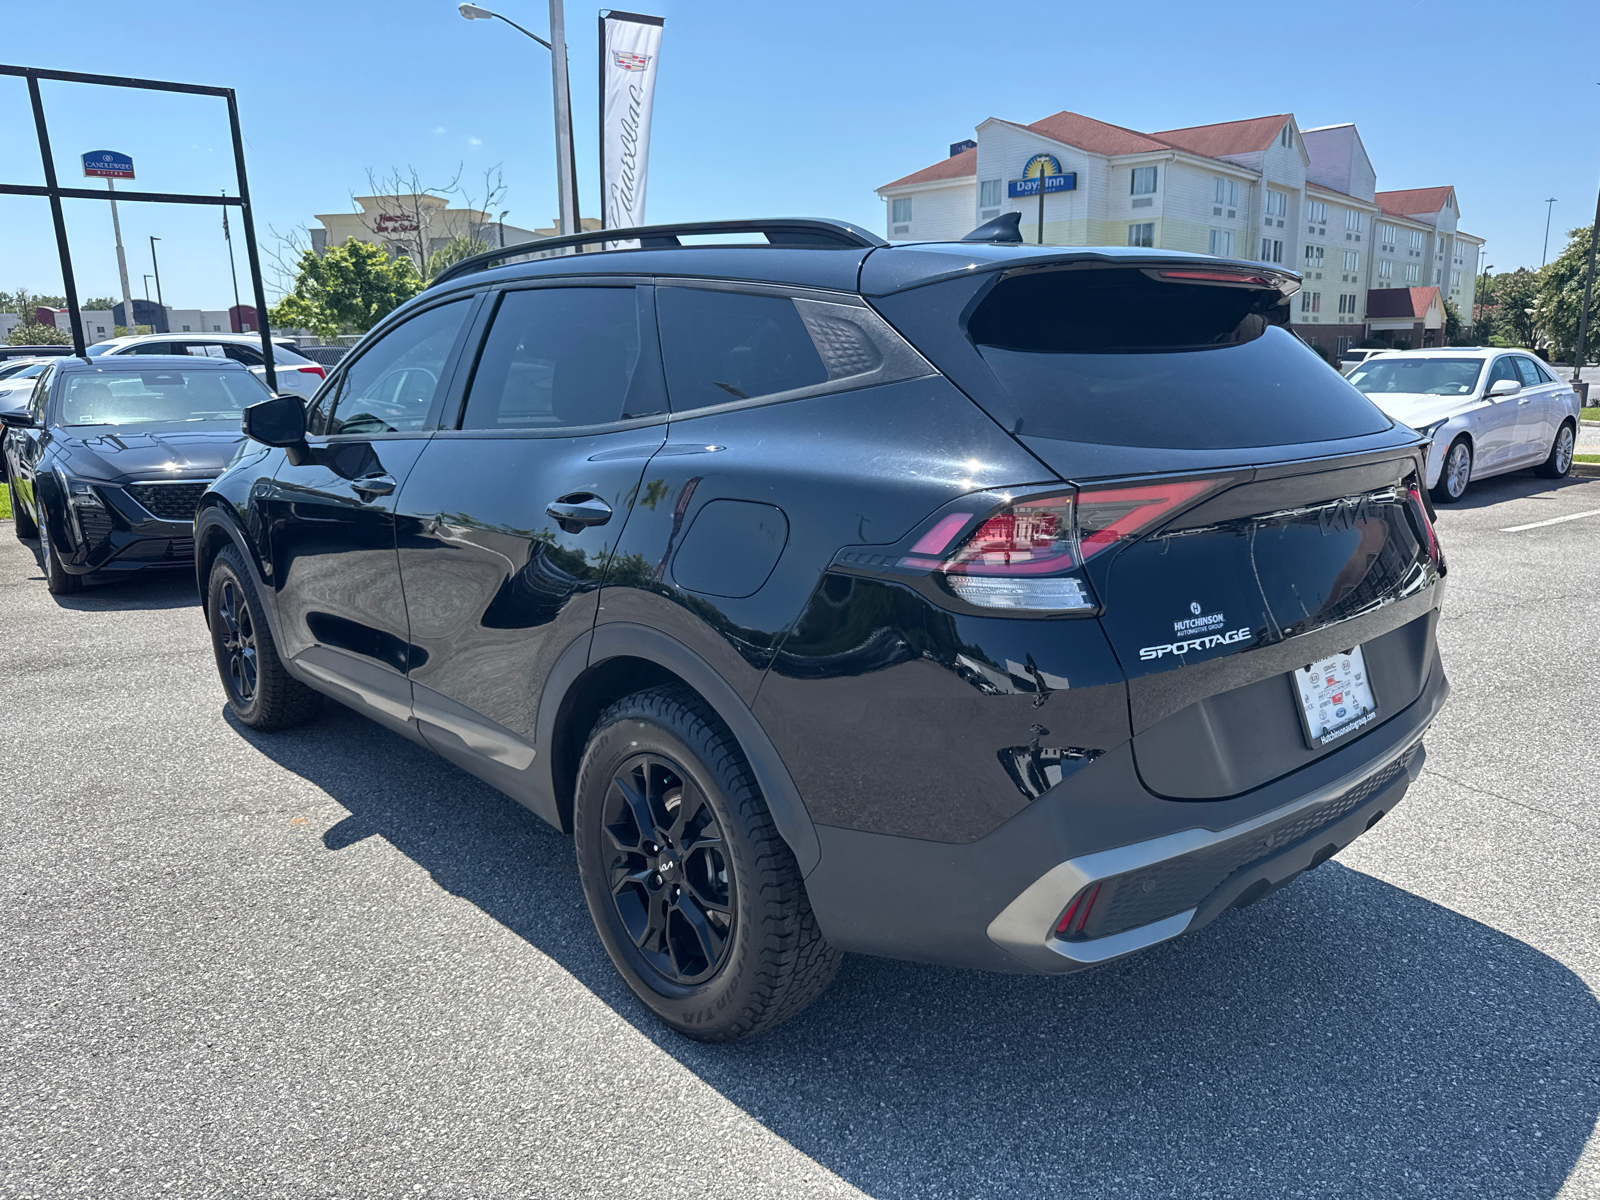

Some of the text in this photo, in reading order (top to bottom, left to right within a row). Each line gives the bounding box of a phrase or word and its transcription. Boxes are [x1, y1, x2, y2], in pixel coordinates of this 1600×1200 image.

[85, 161, 132, 170] CANDLEWOOD
[1045, 178, 1064, 188] Inn
[1174, 612, 1225, 631] HUTCHINSON
[1176, 622, 1224, 637] AUTOMOTIVE GROUP
[1139, 626, 1252, 661] SPORTAGE
